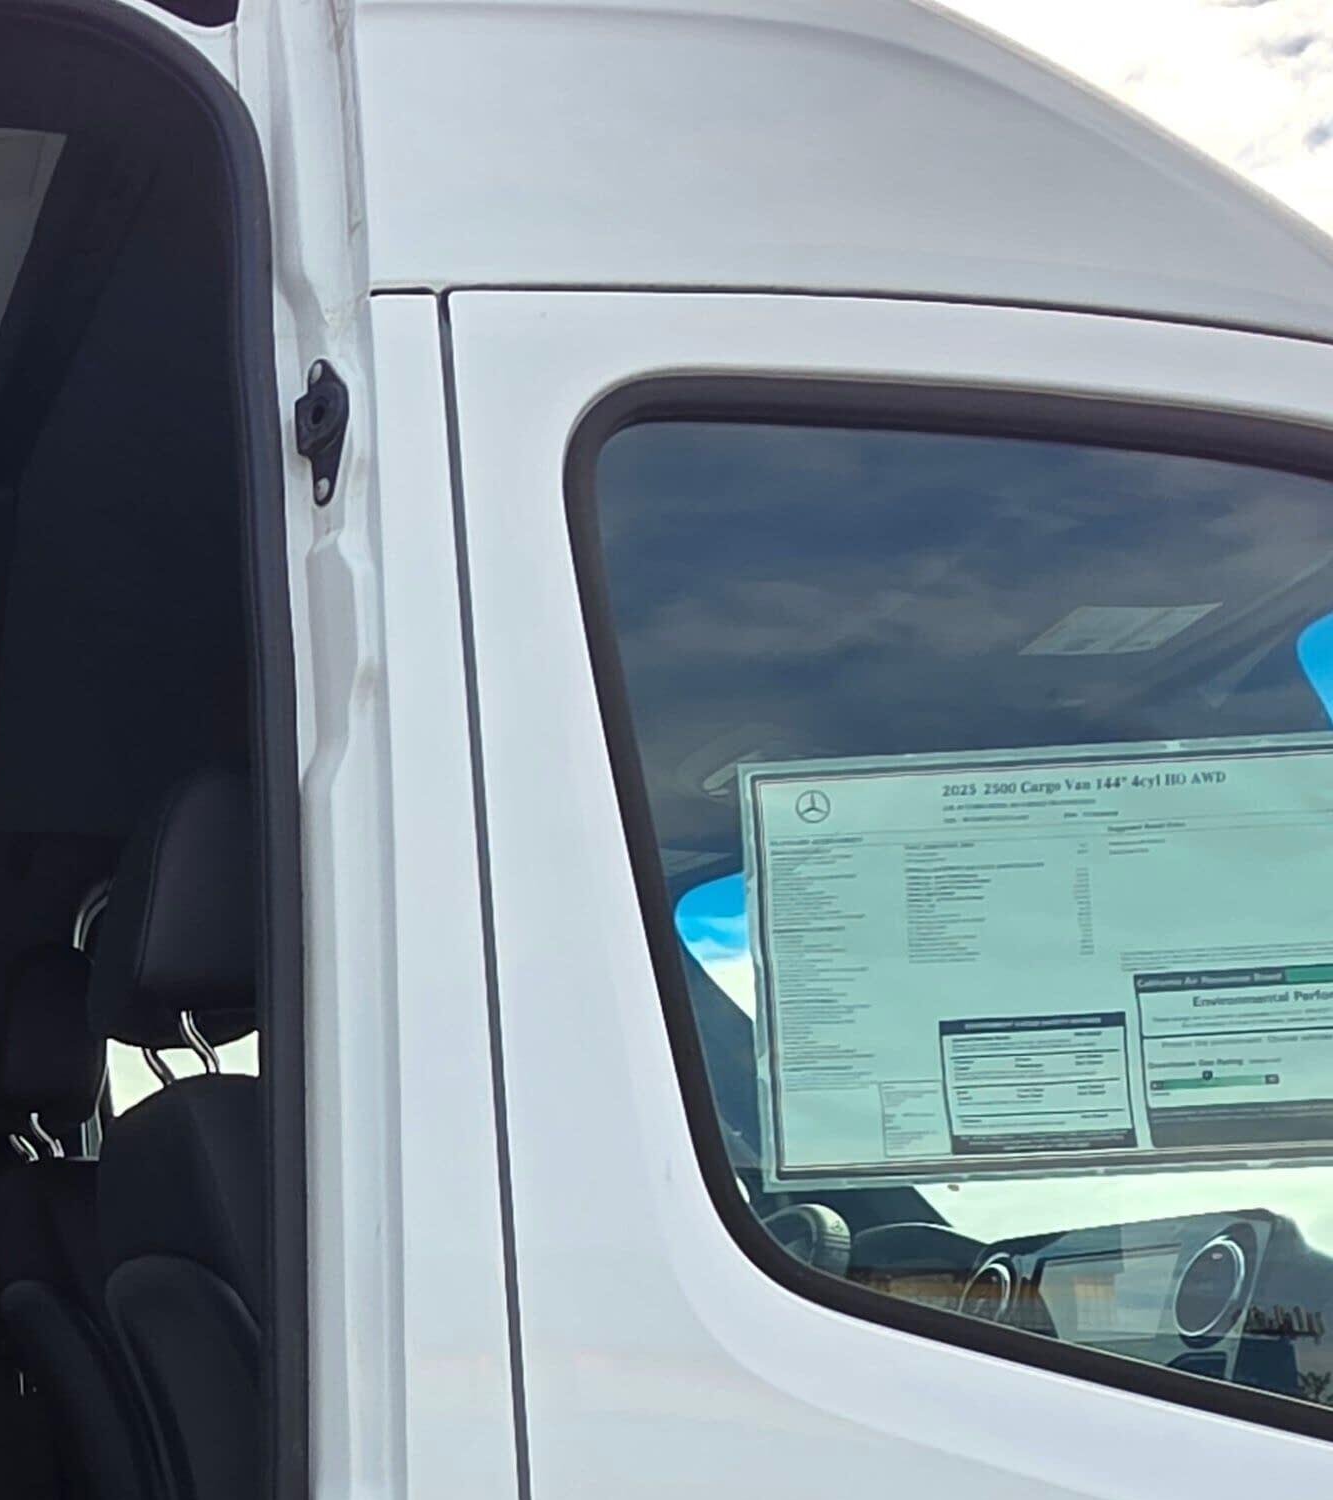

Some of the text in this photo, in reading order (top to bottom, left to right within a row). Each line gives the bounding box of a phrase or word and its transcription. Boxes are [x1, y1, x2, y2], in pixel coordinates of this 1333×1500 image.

[942, 783, 977, 797] 2025
[984, 780, 1016, 795] 2500
[1021, 780, 1062, 795] Cargo
[1065, 778, 1091, 791] Van
[1131, 773, 1161, 790] 4cyl
[1191, 771, 1226, 784] AWD
[1193, 992, 1289, 1007] Environmental
